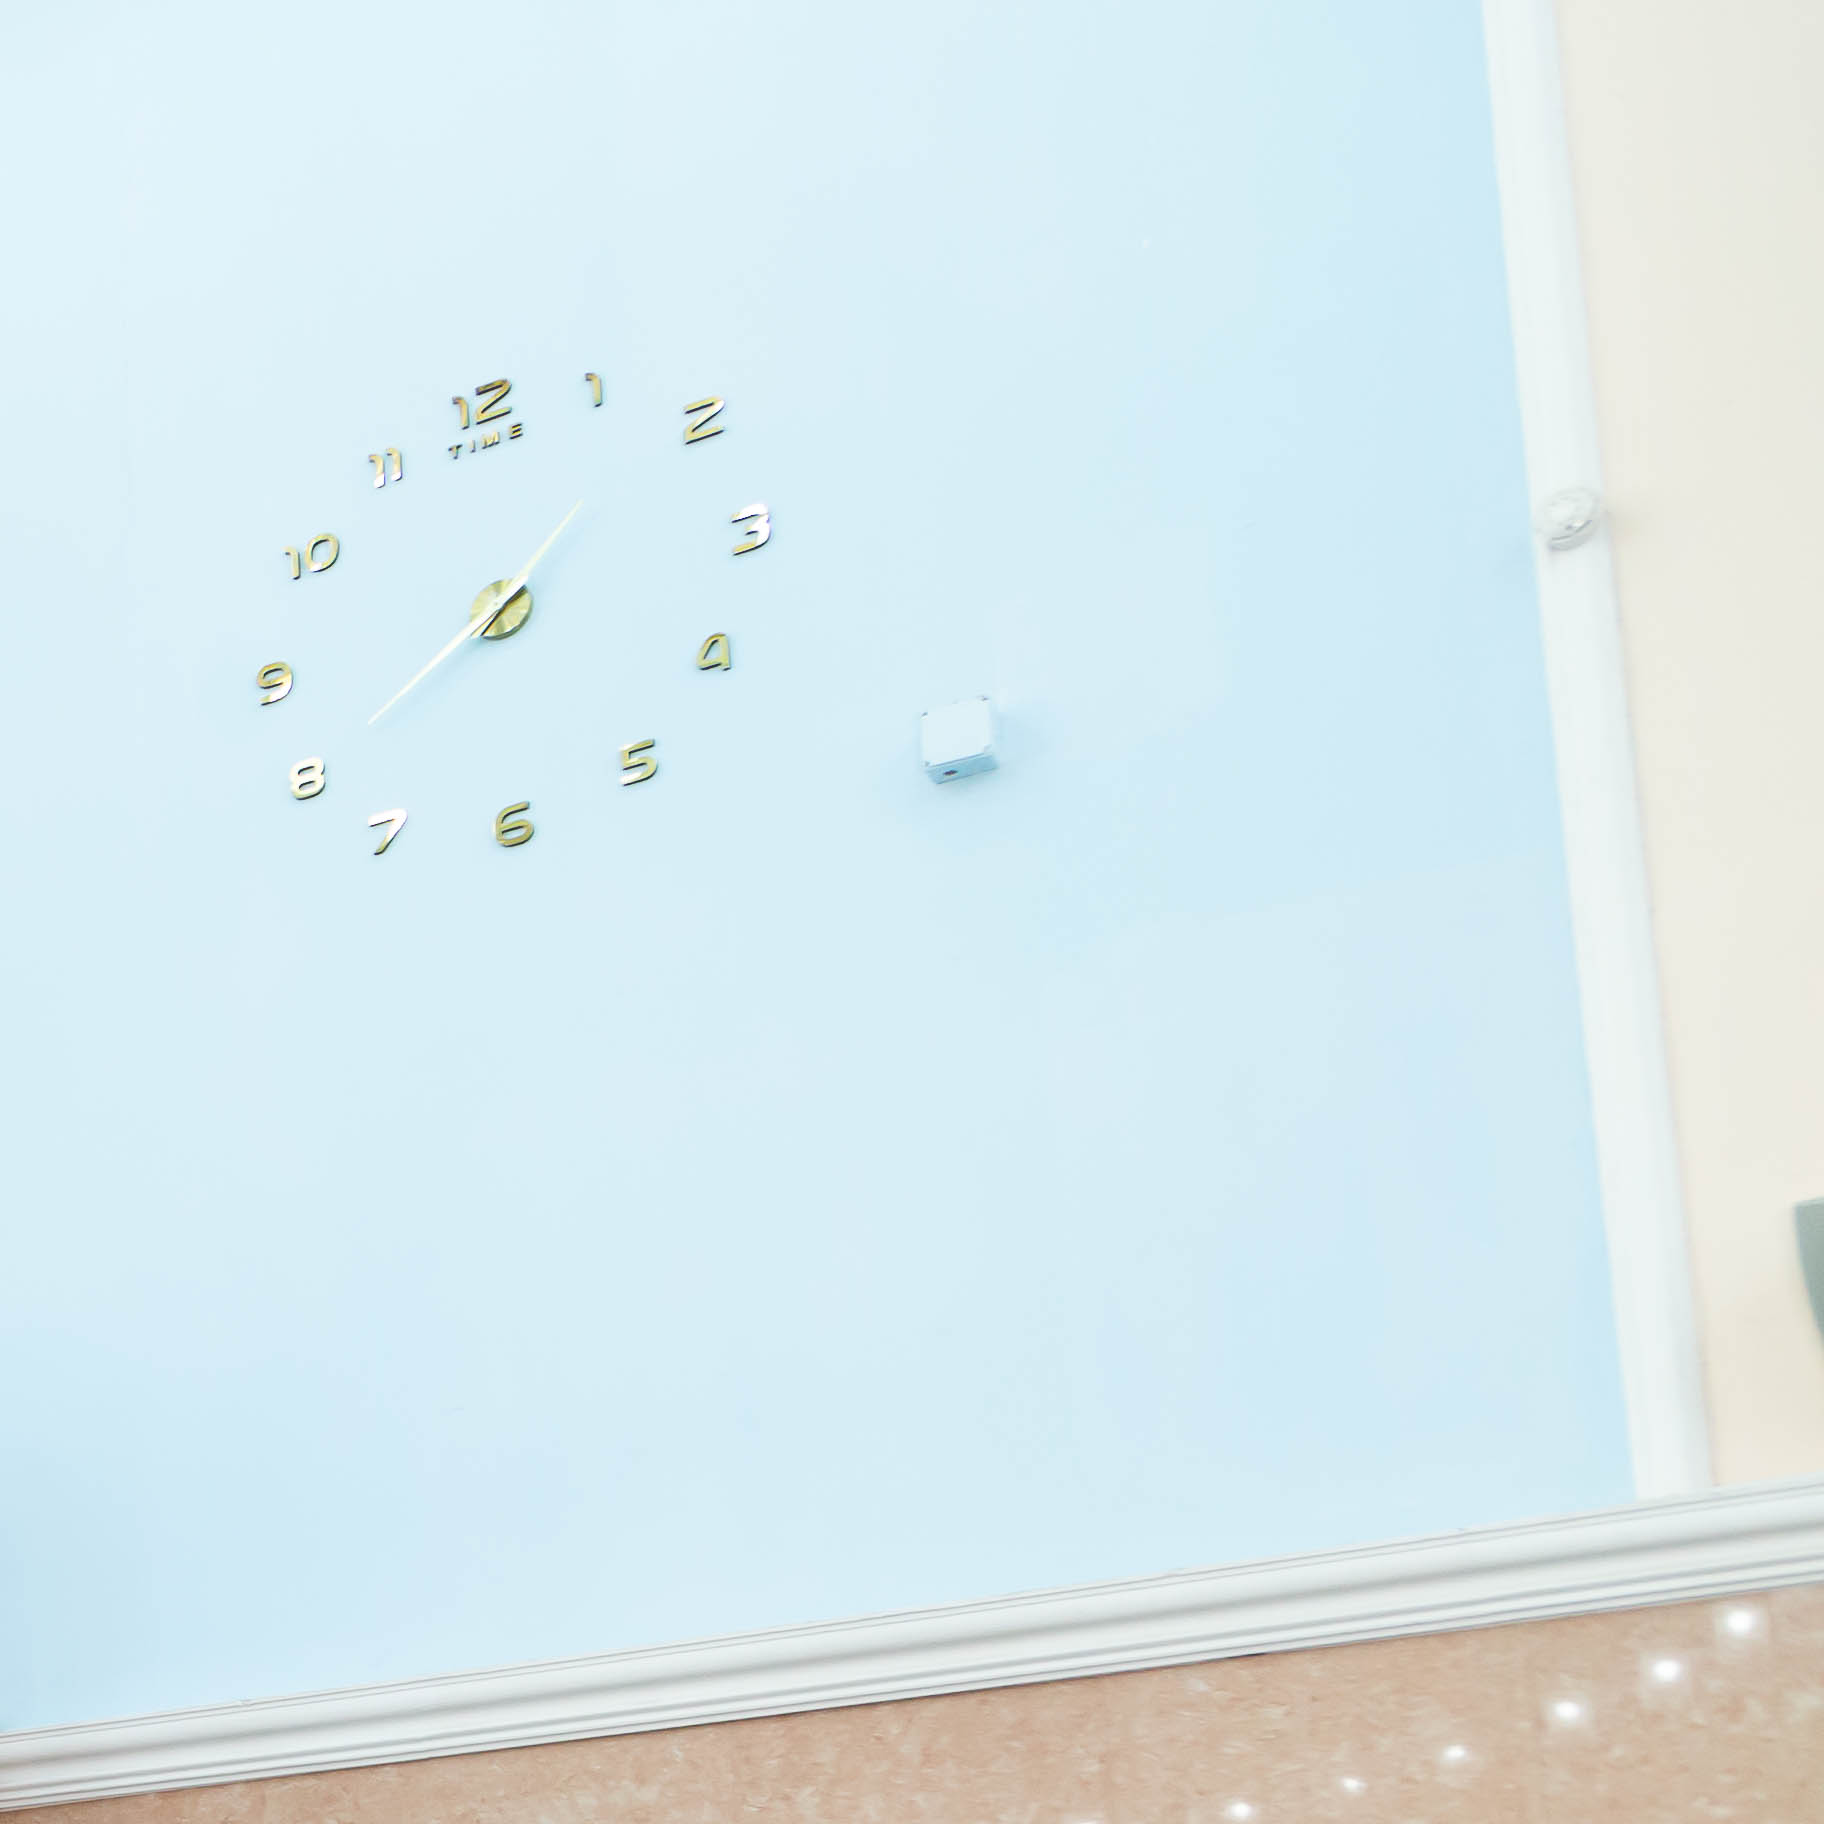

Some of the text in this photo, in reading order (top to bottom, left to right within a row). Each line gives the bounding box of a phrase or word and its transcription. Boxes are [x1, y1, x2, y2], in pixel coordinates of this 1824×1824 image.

[453, 377, 513, 431] 12
[584, 372, 605, 408] 1
[449, 423, 525, 460] TIME
[684, 396, 725, 445] 2
[369, 447, 403, 488] 11
[731, 503, 772, 556] 3
[285, 533, 340, 580] 10
[697, 632, 731, 671] 4
[256, 662, 293, 705] 9
[290, 757, 325, 801] 8
[620, 739, 657, 785] 5
[368, 809, 407, 855] 7
[494, 802, 535, 847] 6
